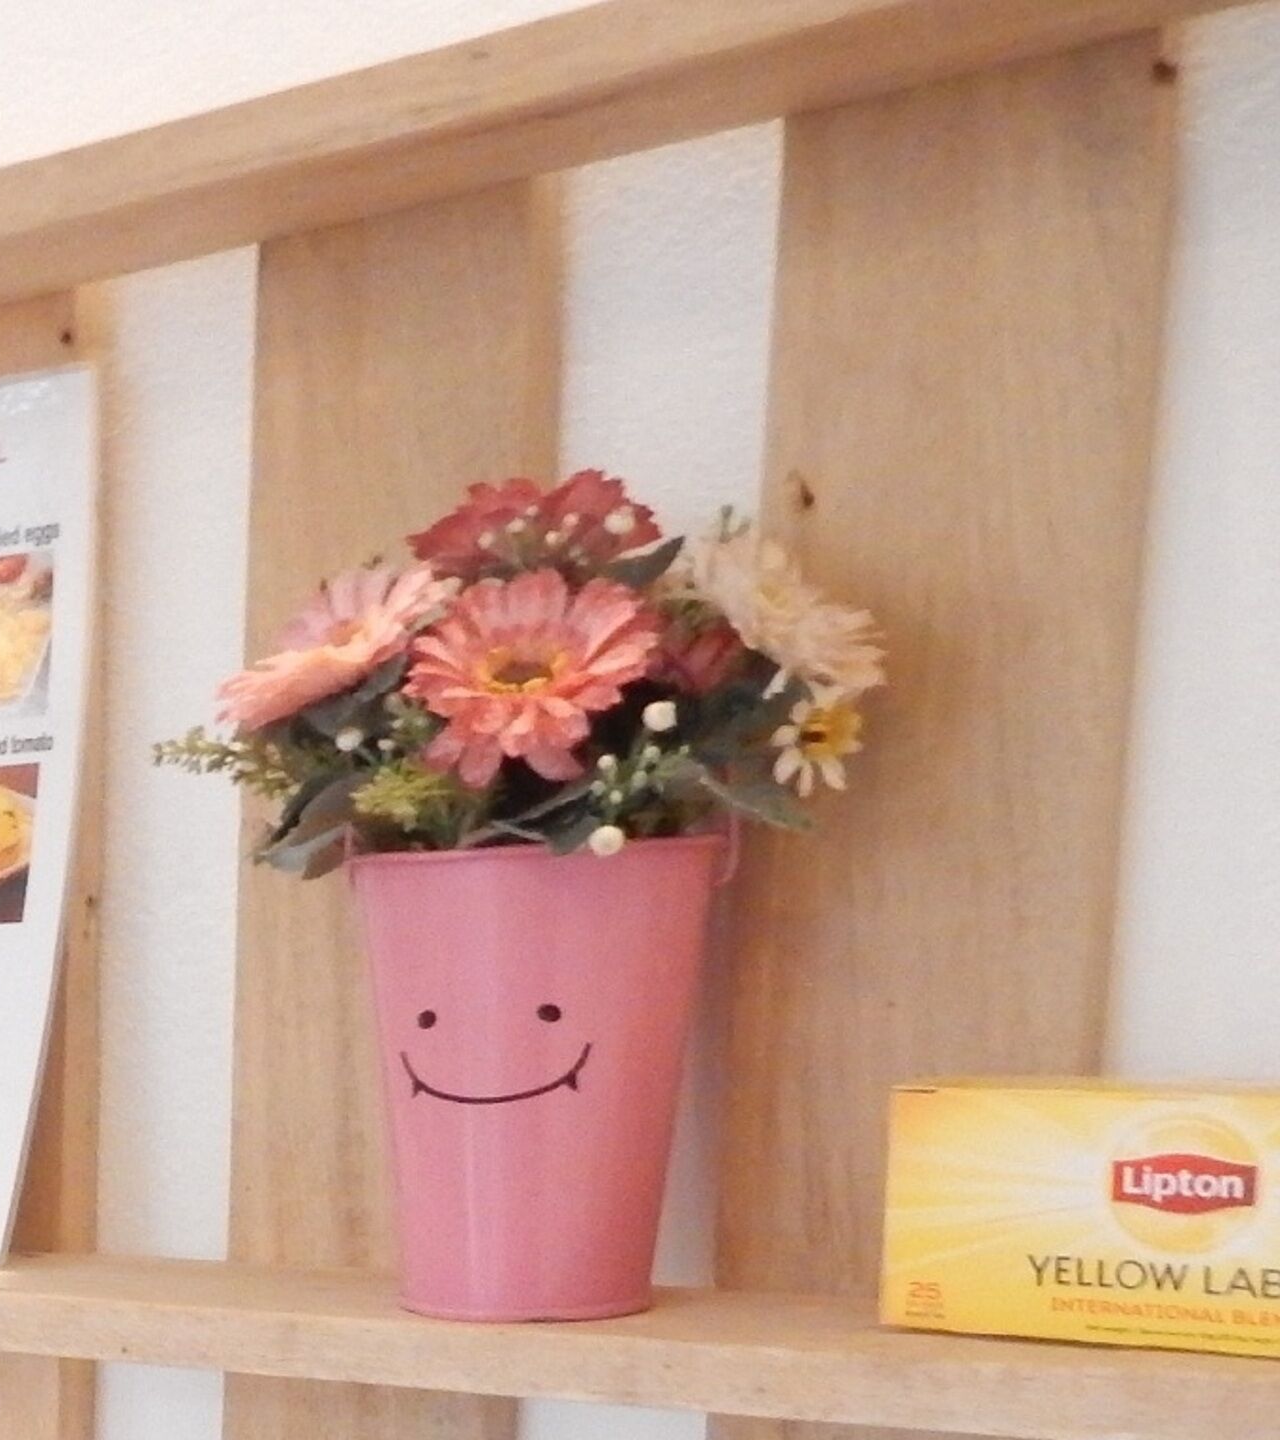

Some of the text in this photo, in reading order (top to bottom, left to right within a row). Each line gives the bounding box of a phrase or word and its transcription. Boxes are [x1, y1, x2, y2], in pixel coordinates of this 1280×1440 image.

[24, 522, 61, 547] eggs
[1121, 1163, 1245, 1202] Lipton
[1026, 1253, 1190, 1292] YELLOW
[1051, 1296, 1225, 1324] INTERNATIONAL
